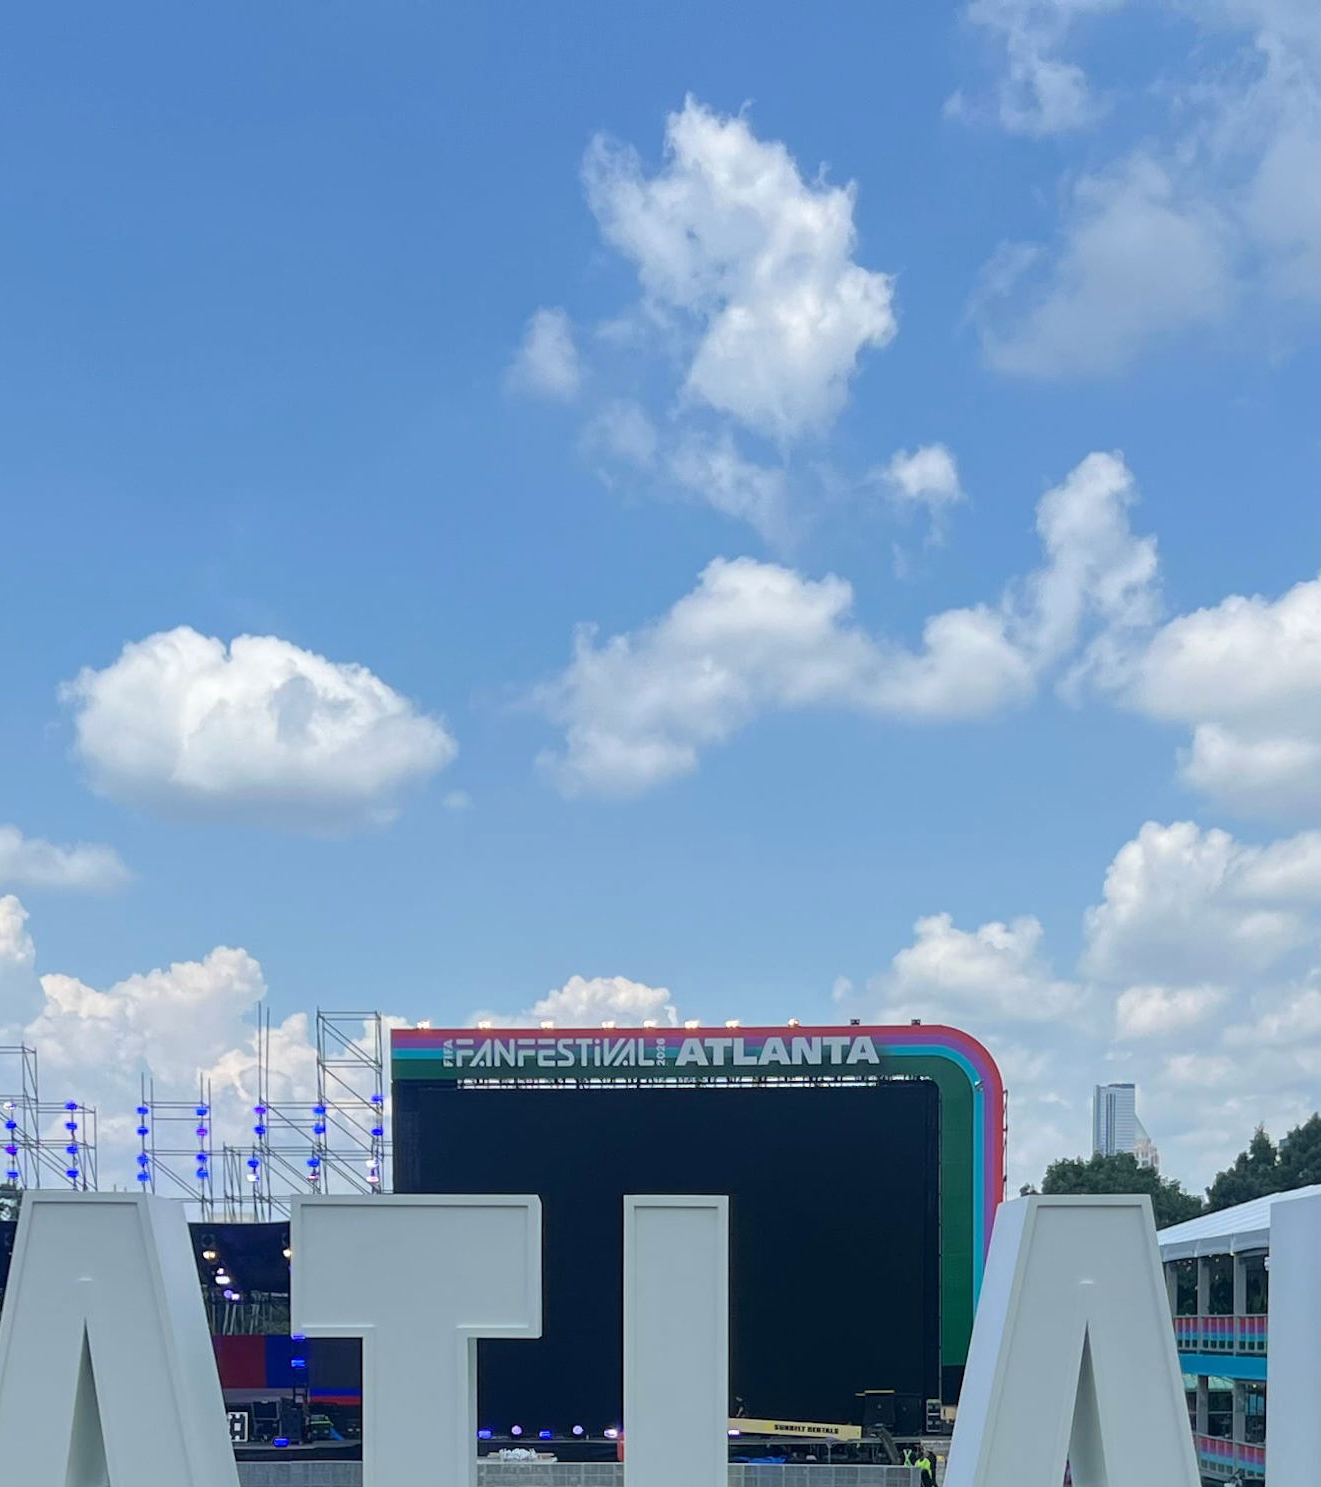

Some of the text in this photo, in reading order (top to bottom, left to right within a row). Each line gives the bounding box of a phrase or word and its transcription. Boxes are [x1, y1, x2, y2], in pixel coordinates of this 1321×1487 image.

[443, 1038, 454, 1067] FIFA
[656, 1038, 666, 1065] 2026
[675, 1036, 880, 1066] ATLANTA
